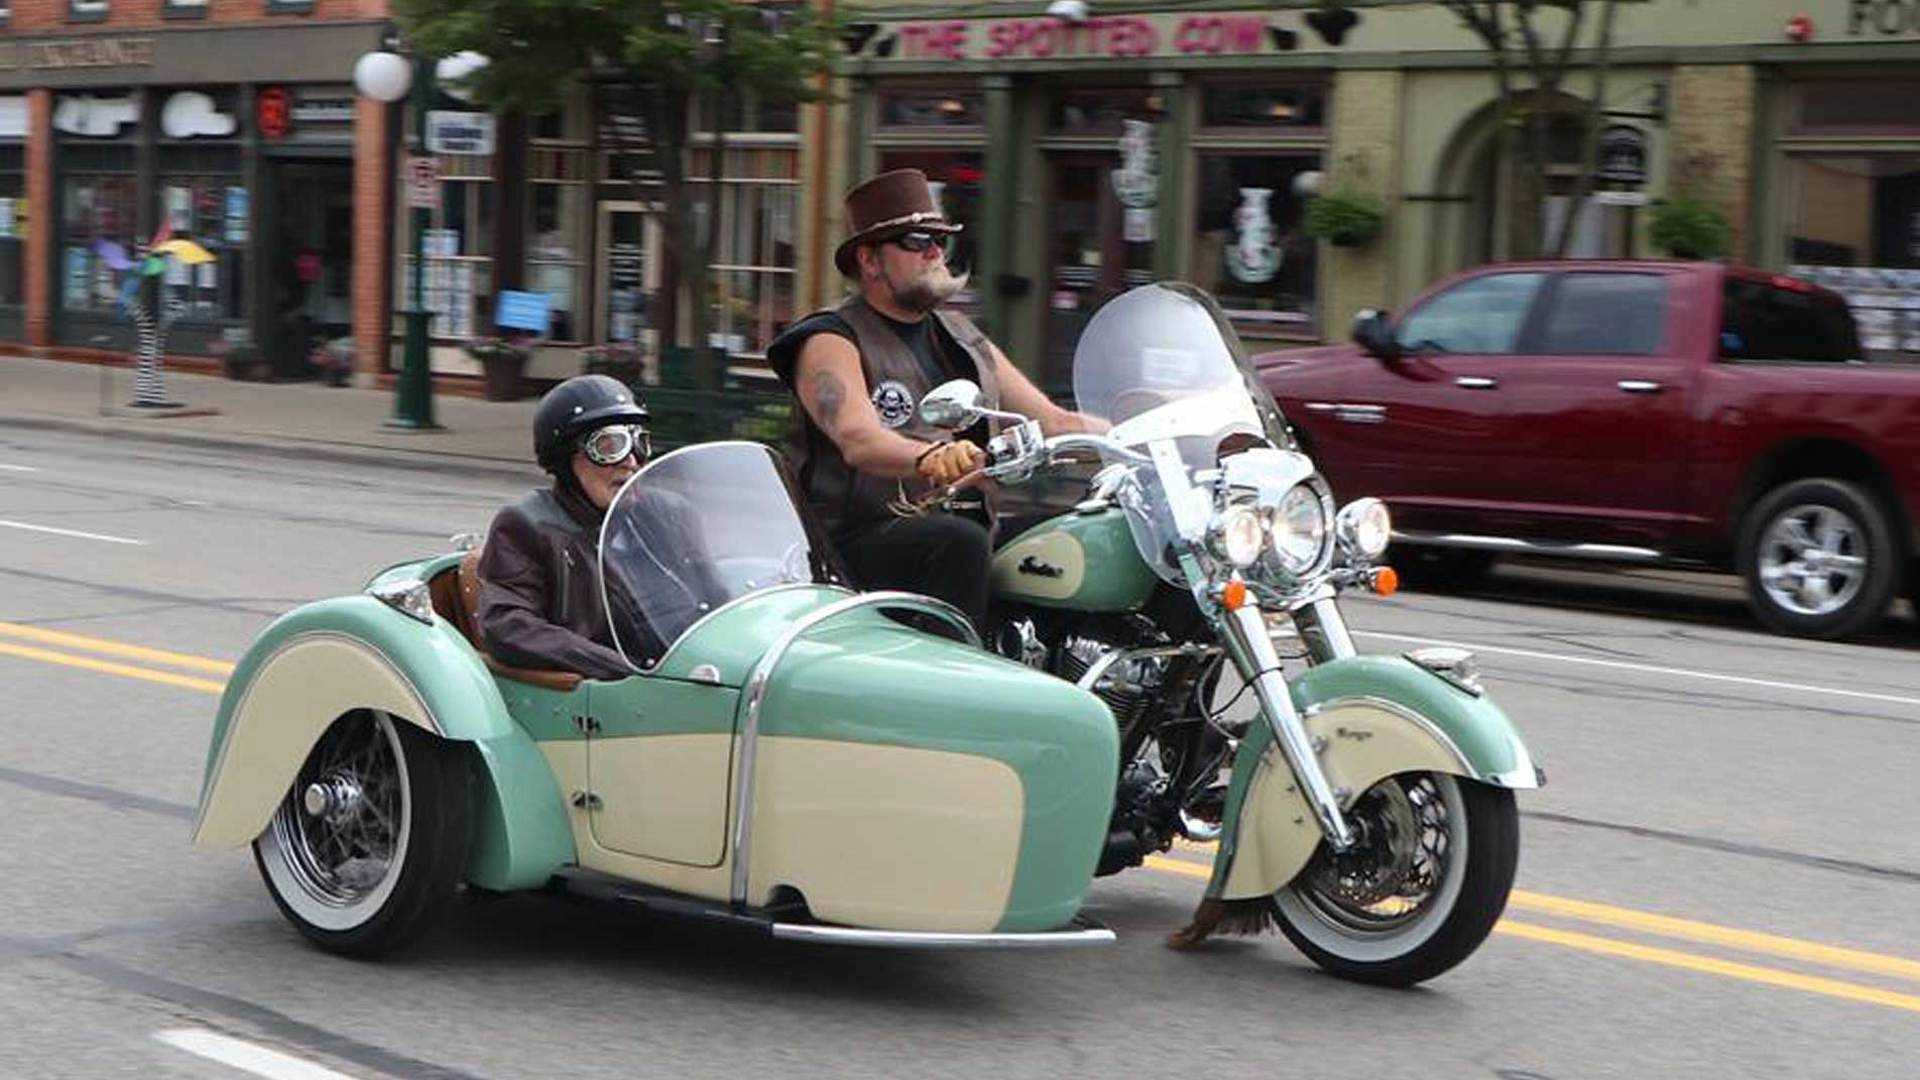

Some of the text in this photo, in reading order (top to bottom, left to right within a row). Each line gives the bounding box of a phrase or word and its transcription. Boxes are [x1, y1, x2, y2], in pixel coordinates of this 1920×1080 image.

[896, 15, 1267, 60] THE SPOTTED COW
